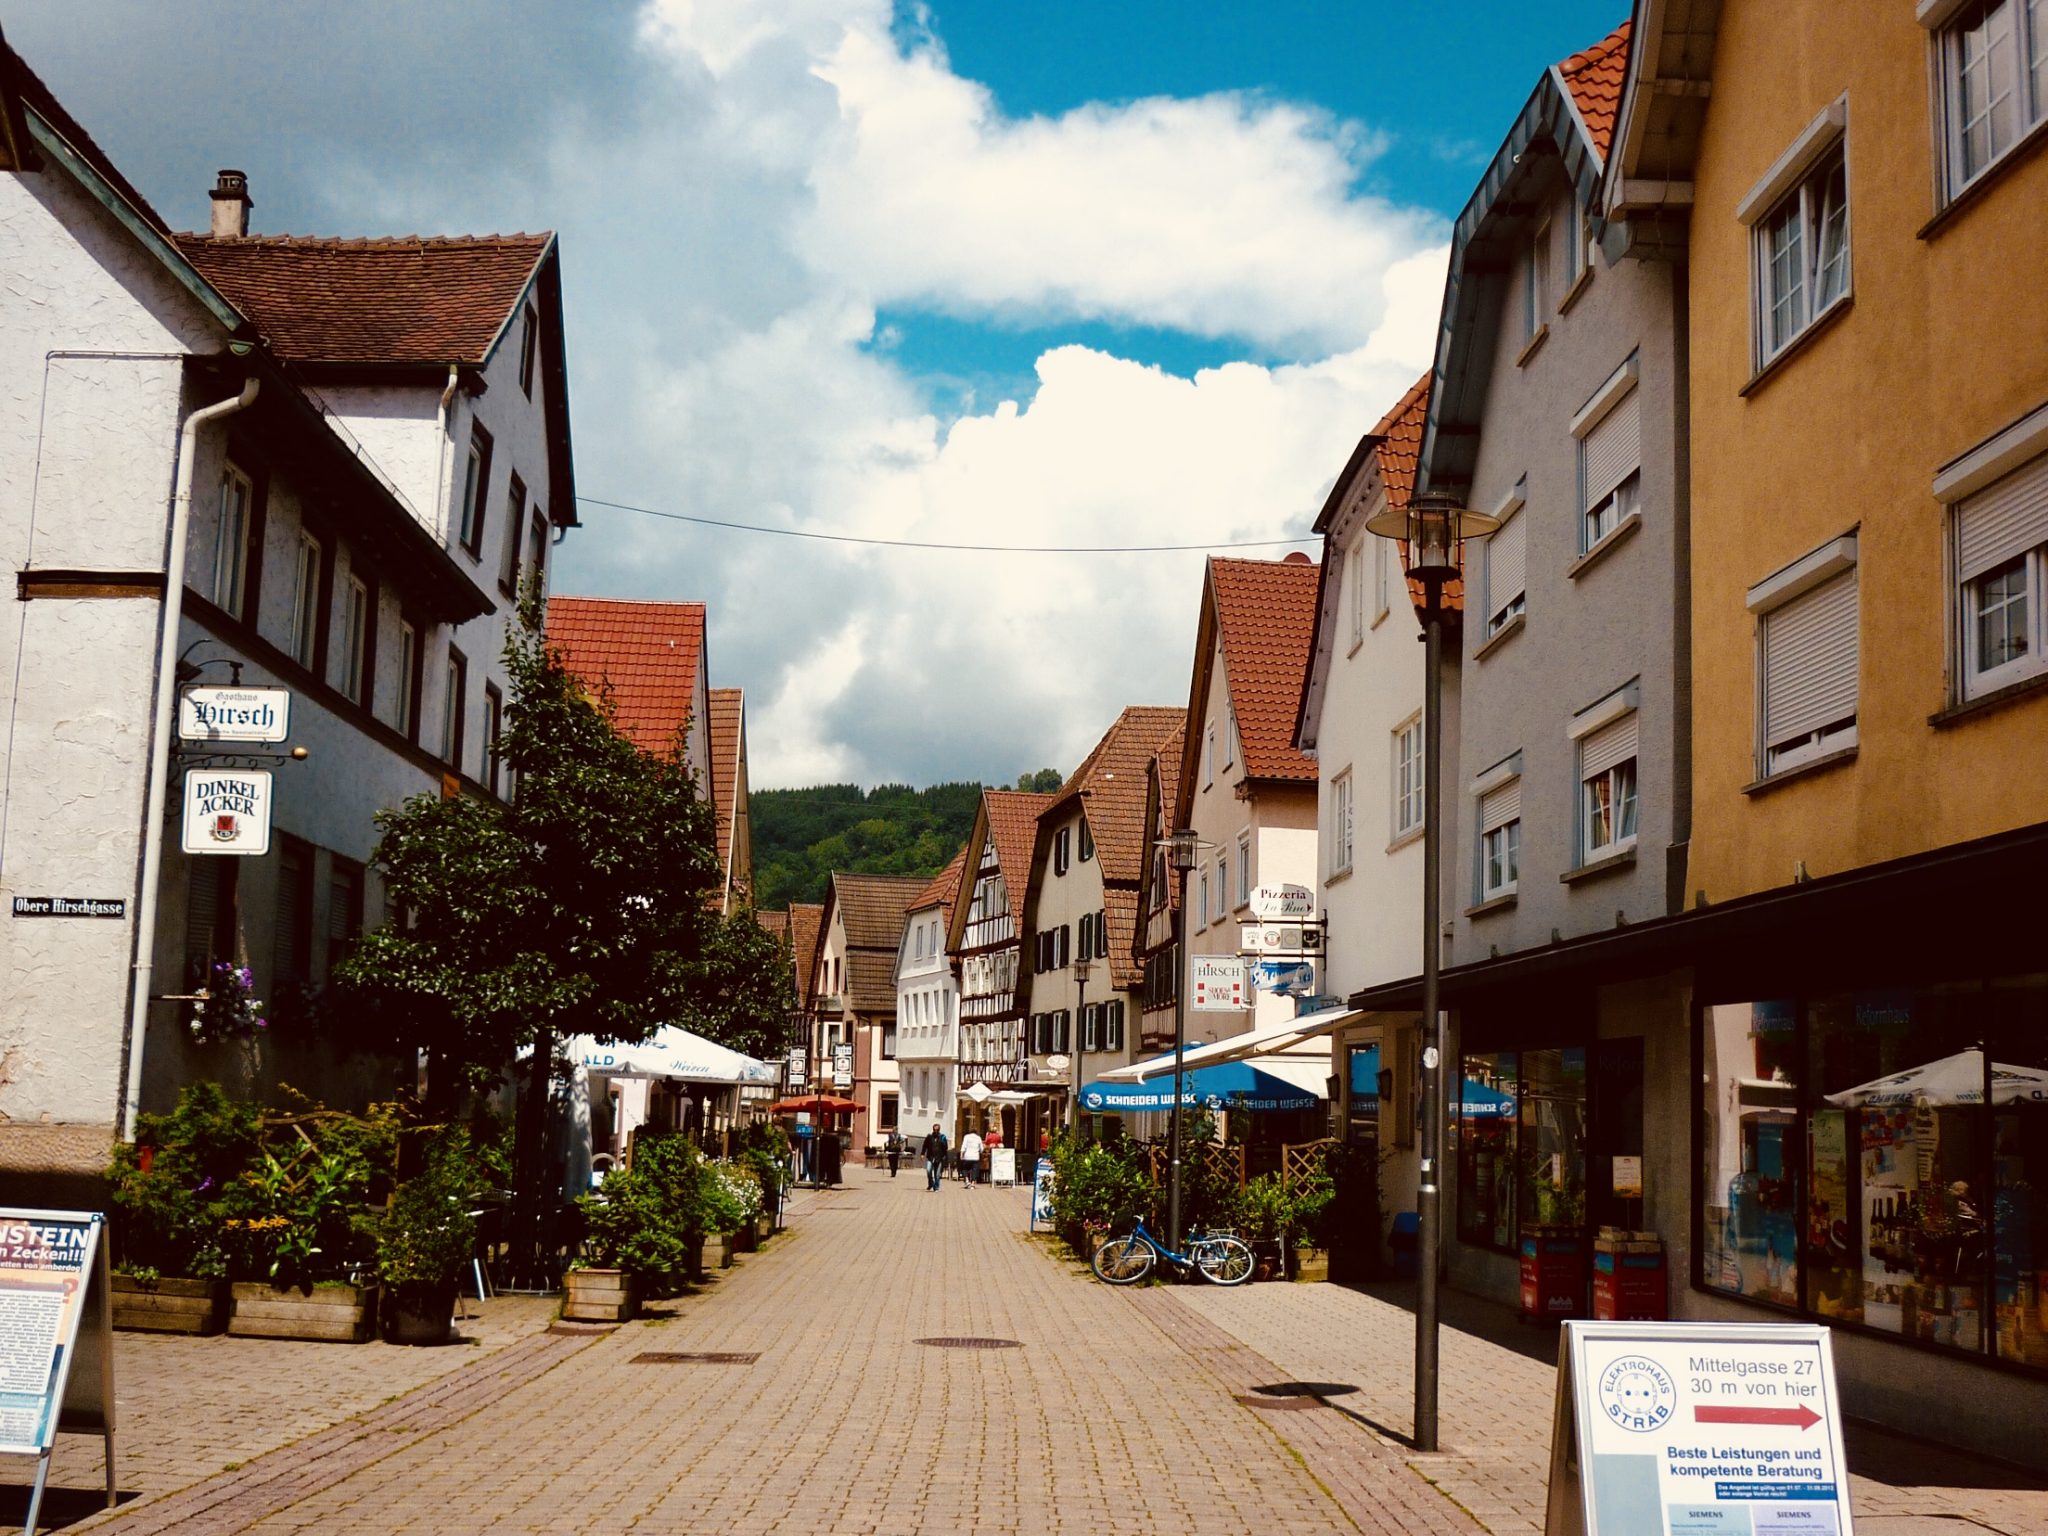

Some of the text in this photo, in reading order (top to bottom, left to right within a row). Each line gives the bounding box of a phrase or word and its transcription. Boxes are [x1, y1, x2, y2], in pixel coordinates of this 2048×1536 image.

[216, 692, 258, 701] Gasthaus
[193, 701, 274, 730] Hirsch
[197, 780, 260, 801] DINKEL
[198, 796, 255, 816] ACKER
[1261, 889, 1306, 900] Pizzeria
[16, 898, 122, 917] Obere Hirschgasse
[1198, 963, 1240, 977] HIRSCH
[1106, 1094, 1158, 1106] SCHNEIDER
[1280, 1098, 1316, 1109] WEISSE
[12, 1246, 86, 1262] Zecken!!!
[1689, 1357, 1814, 1377] Mittelgasse 27
[1605, 1361, 1670, 1394] ELEKTROHAUS
[1691, 1378, 1817, 1397] 30 m von hier
[1667, 1446, 1822, 1462] Beste Leistungen und
[1670, 1464, 1823, 1480] kompetente Beratung
[1777, 1511, 1812, 1519] SIEMENS
